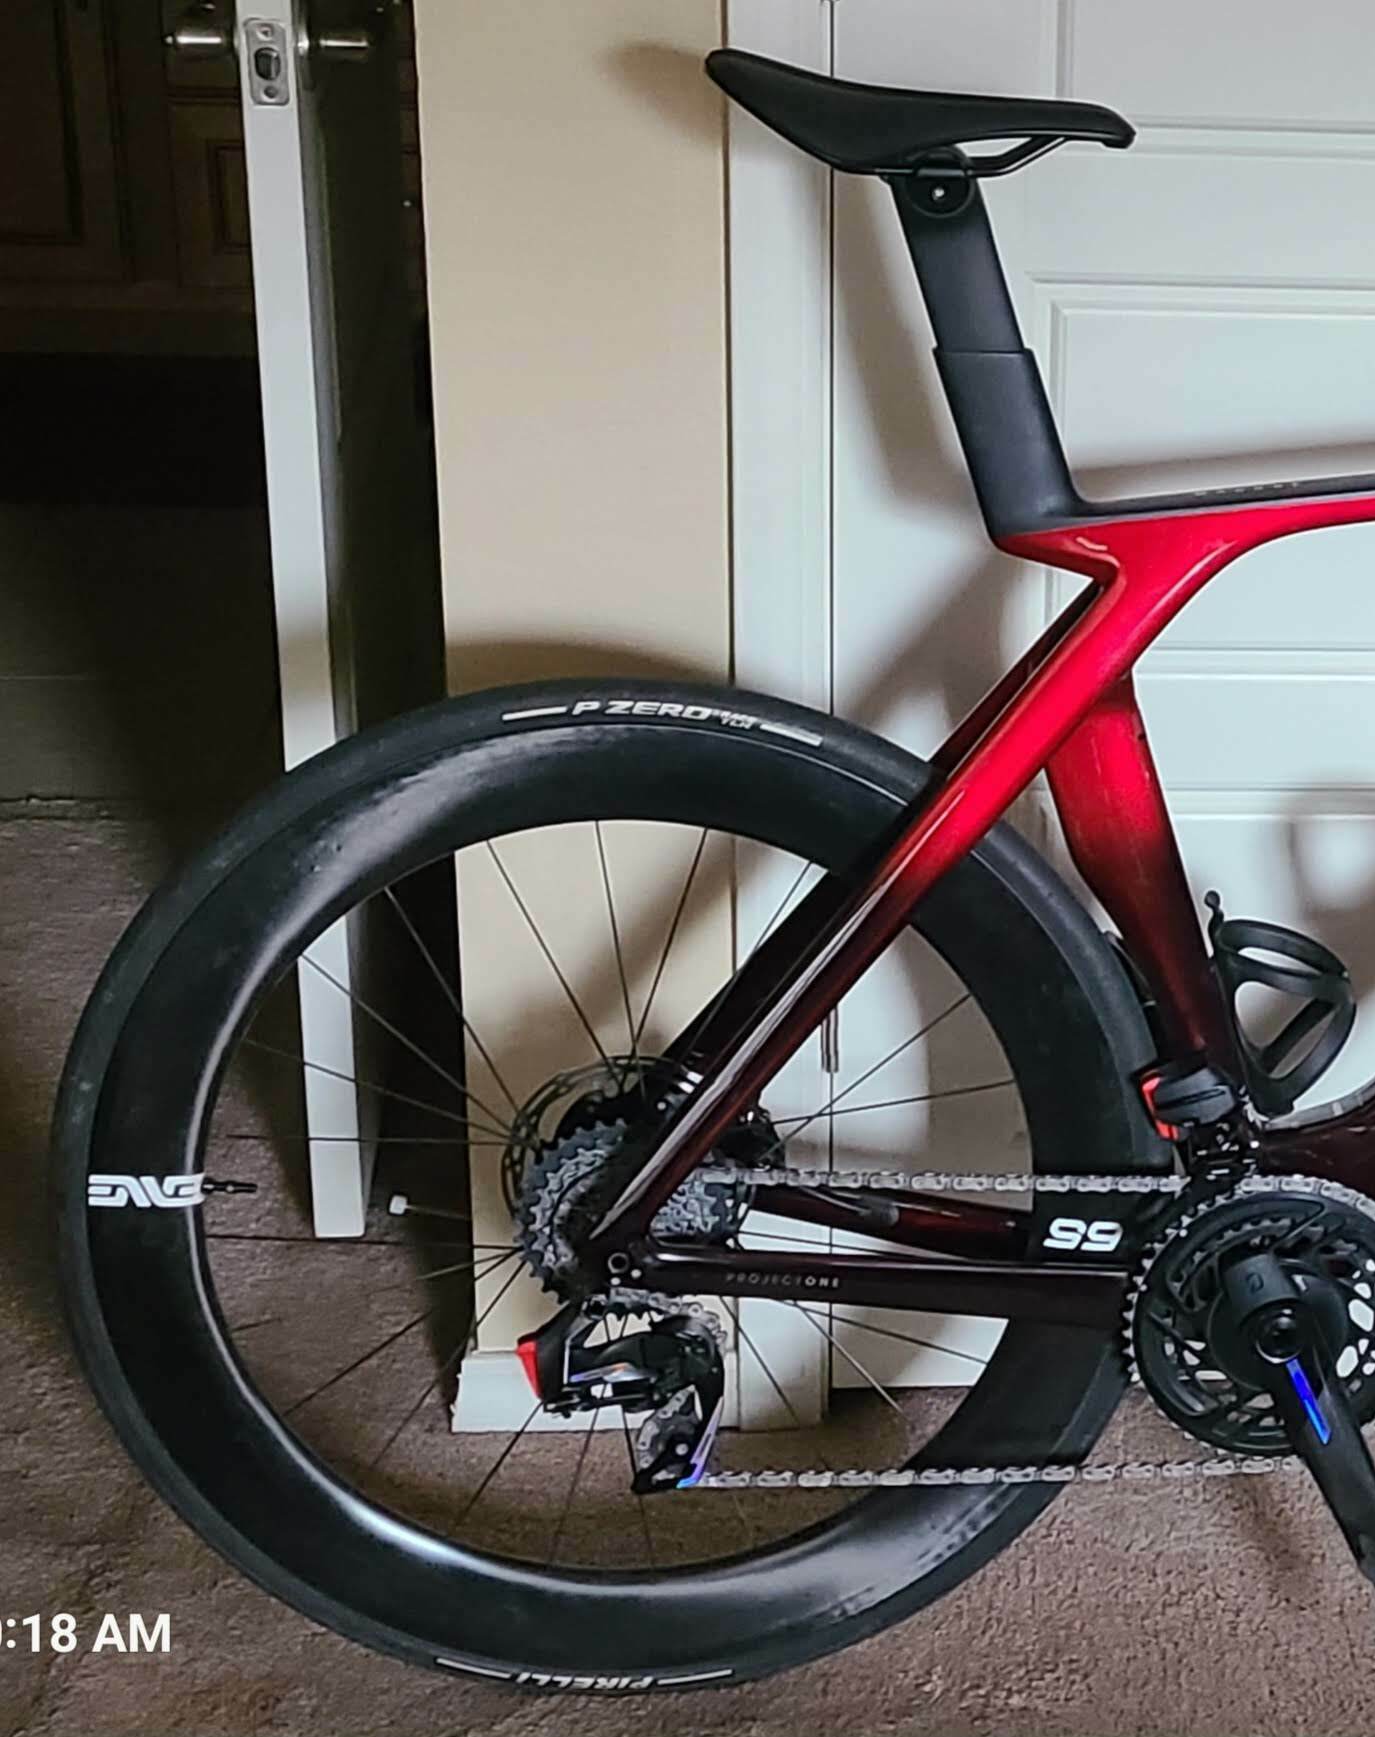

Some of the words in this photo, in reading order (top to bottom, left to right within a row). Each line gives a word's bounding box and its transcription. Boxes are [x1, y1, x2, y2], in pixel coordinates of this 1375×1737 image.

[571, 701, 600, 716] P
[604, 700, 715, 721] ZERO
[87, 1173, 206, 1208] ENVE
[515, 1671, 655, 1689] PIRELLI
